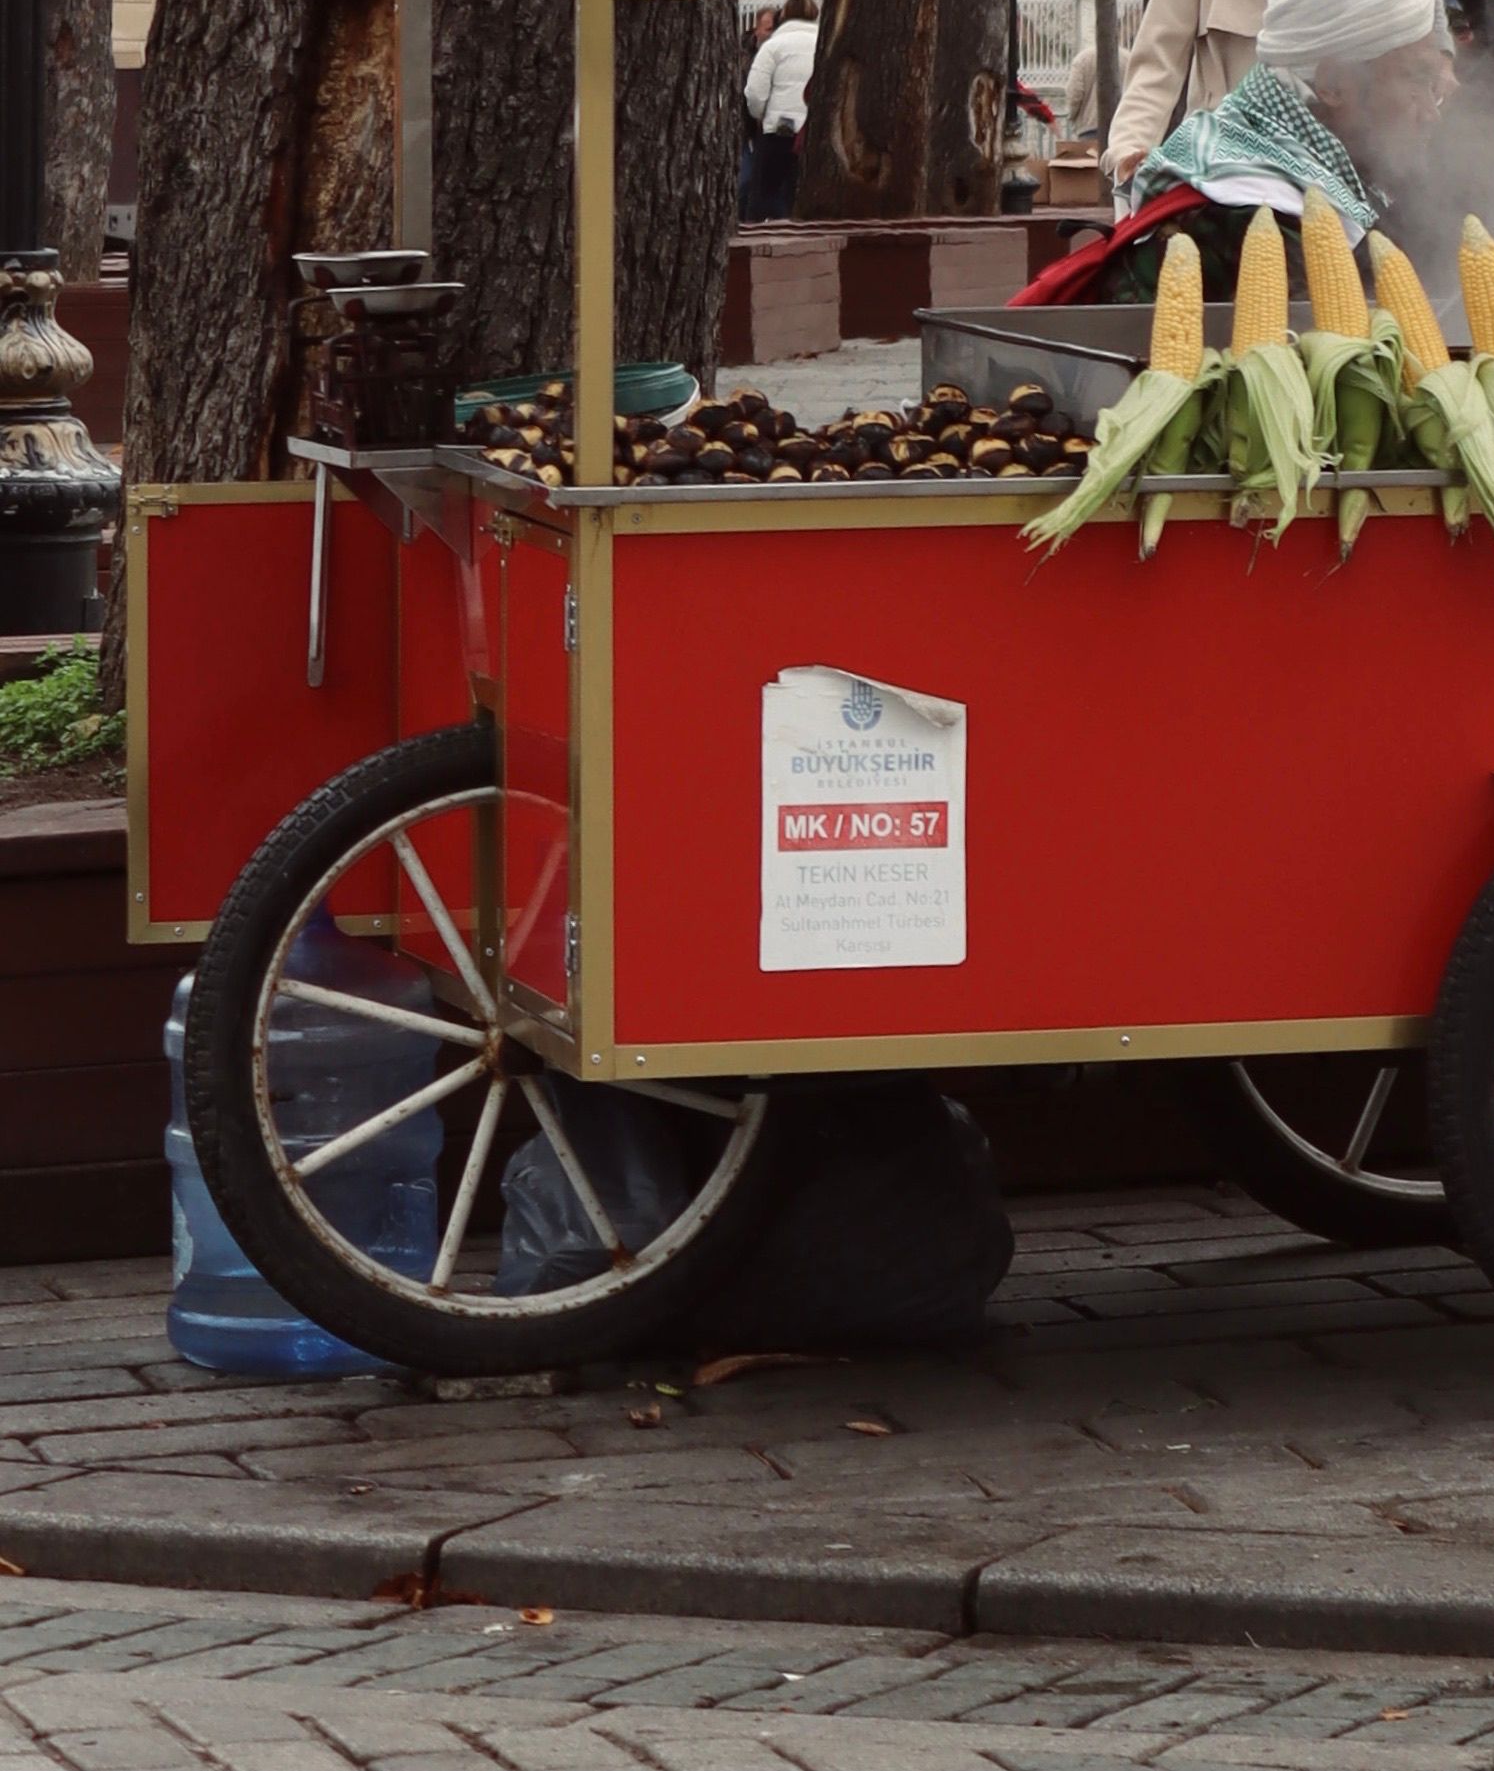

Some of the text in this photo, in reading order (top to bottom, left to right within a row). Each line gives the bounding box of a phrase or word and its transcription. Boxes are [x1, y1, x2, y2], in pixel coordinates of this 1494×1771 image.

[784, 811, 940, 840] MK / NO: 57
[797, 862, 929, 884] TEKİN KESER
